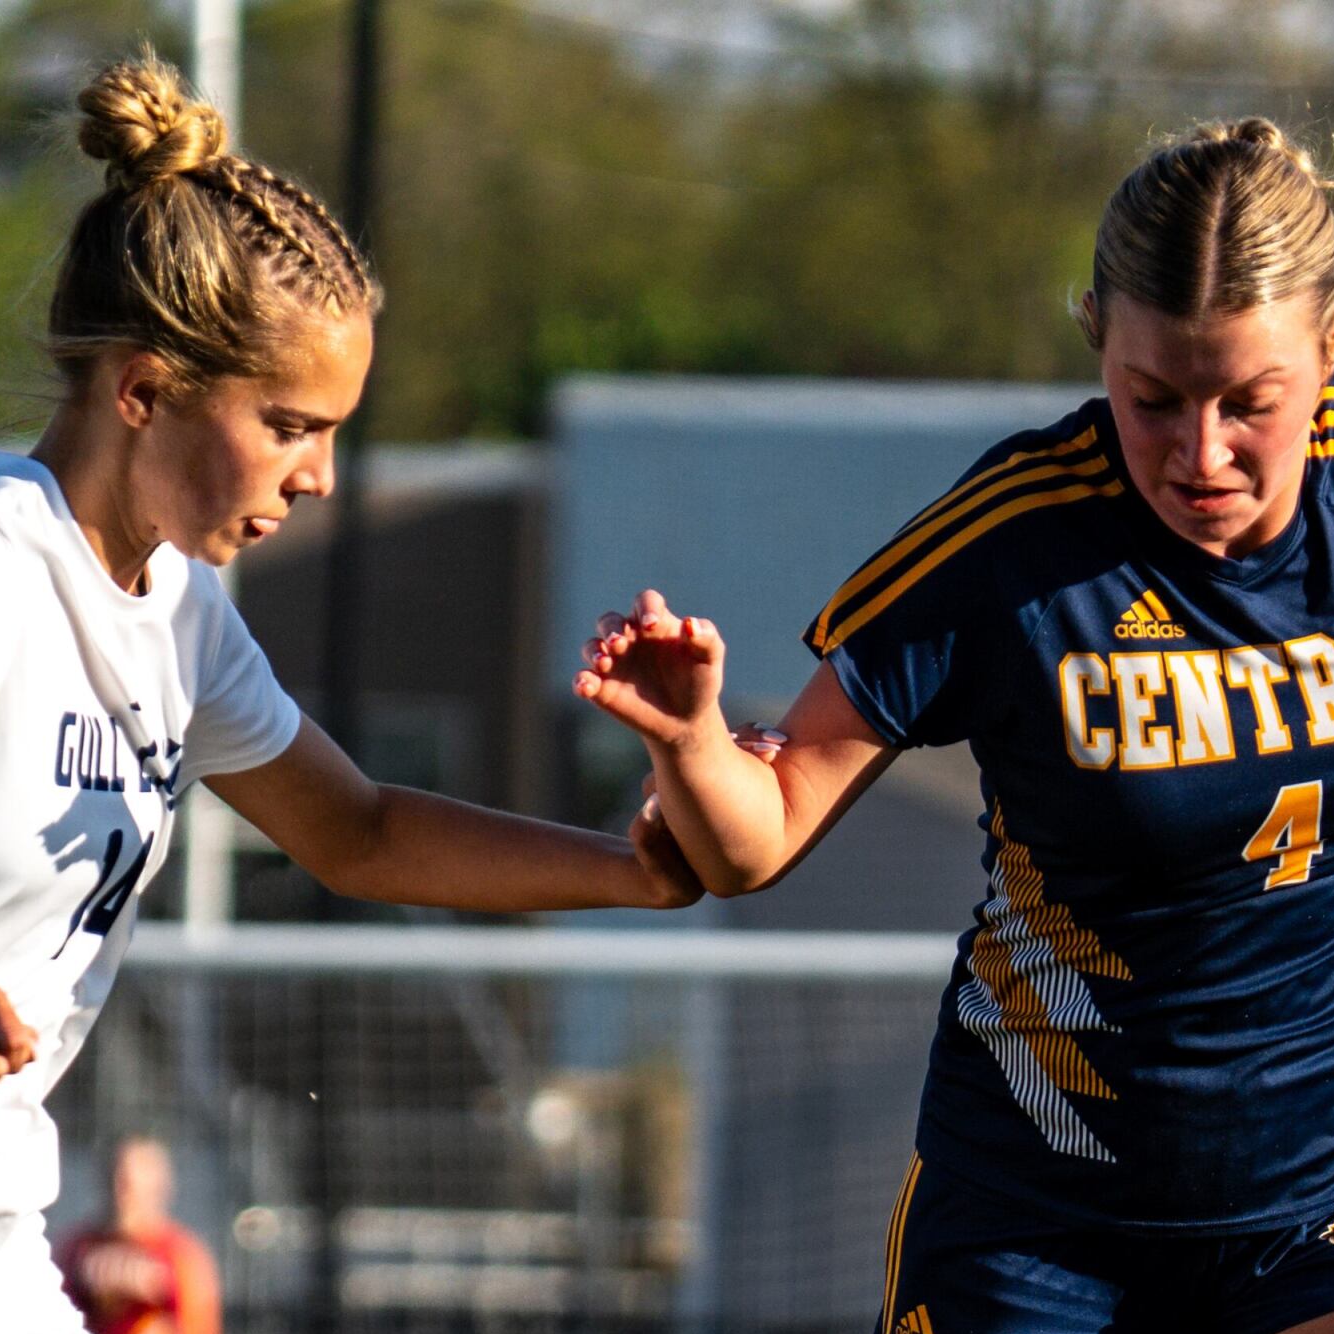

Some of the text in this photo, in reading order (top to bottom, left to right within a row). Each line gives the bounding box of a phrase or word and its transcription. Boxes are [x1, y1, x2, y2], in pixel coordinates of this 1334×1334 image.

[1114, 619, 1187, 640] adidas
[53, 710, 125, 793] GULL
[1241, 779, 1325, 892] 4
[51, 828, 155, 961] 14
